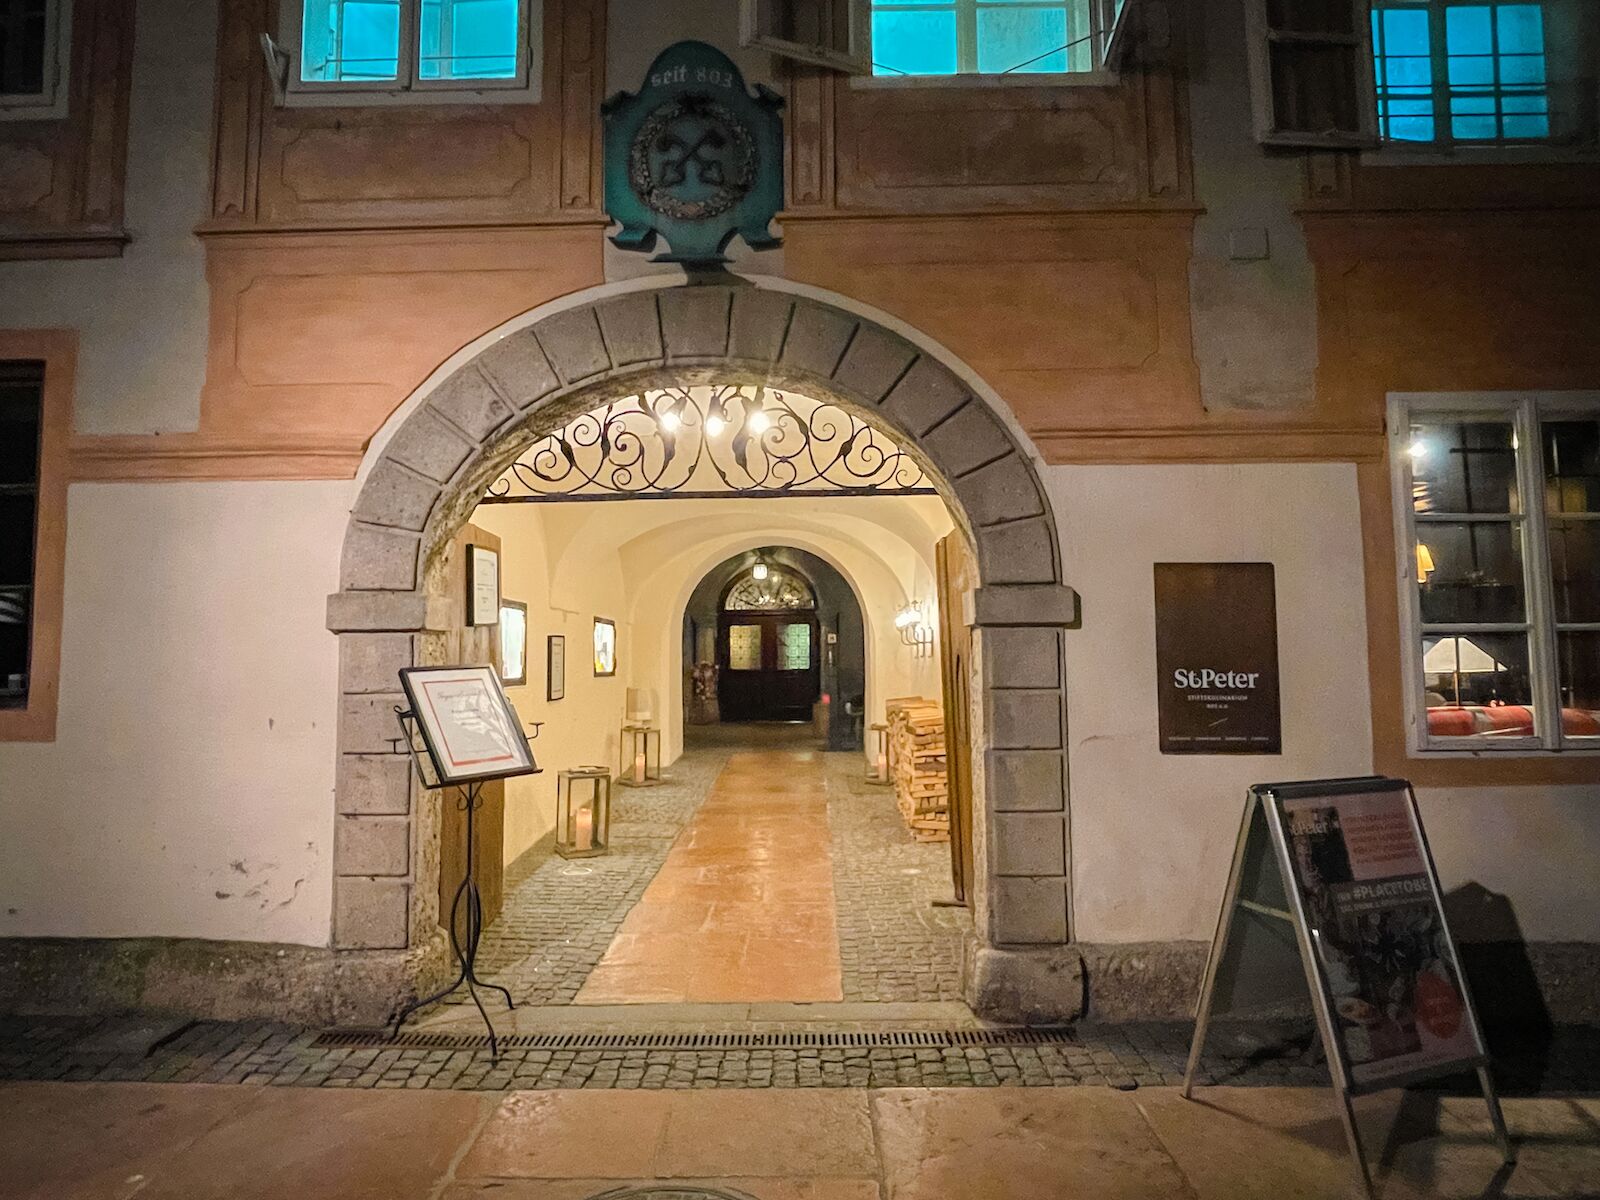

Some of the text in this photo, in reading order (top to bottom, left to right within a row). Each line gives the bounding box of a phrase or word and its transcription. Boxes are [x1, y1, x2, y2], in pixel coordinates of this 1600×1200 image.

[651, 64, 733, 88] seit 803
[1353, 878, 1428, 900] #PLACETOBE
